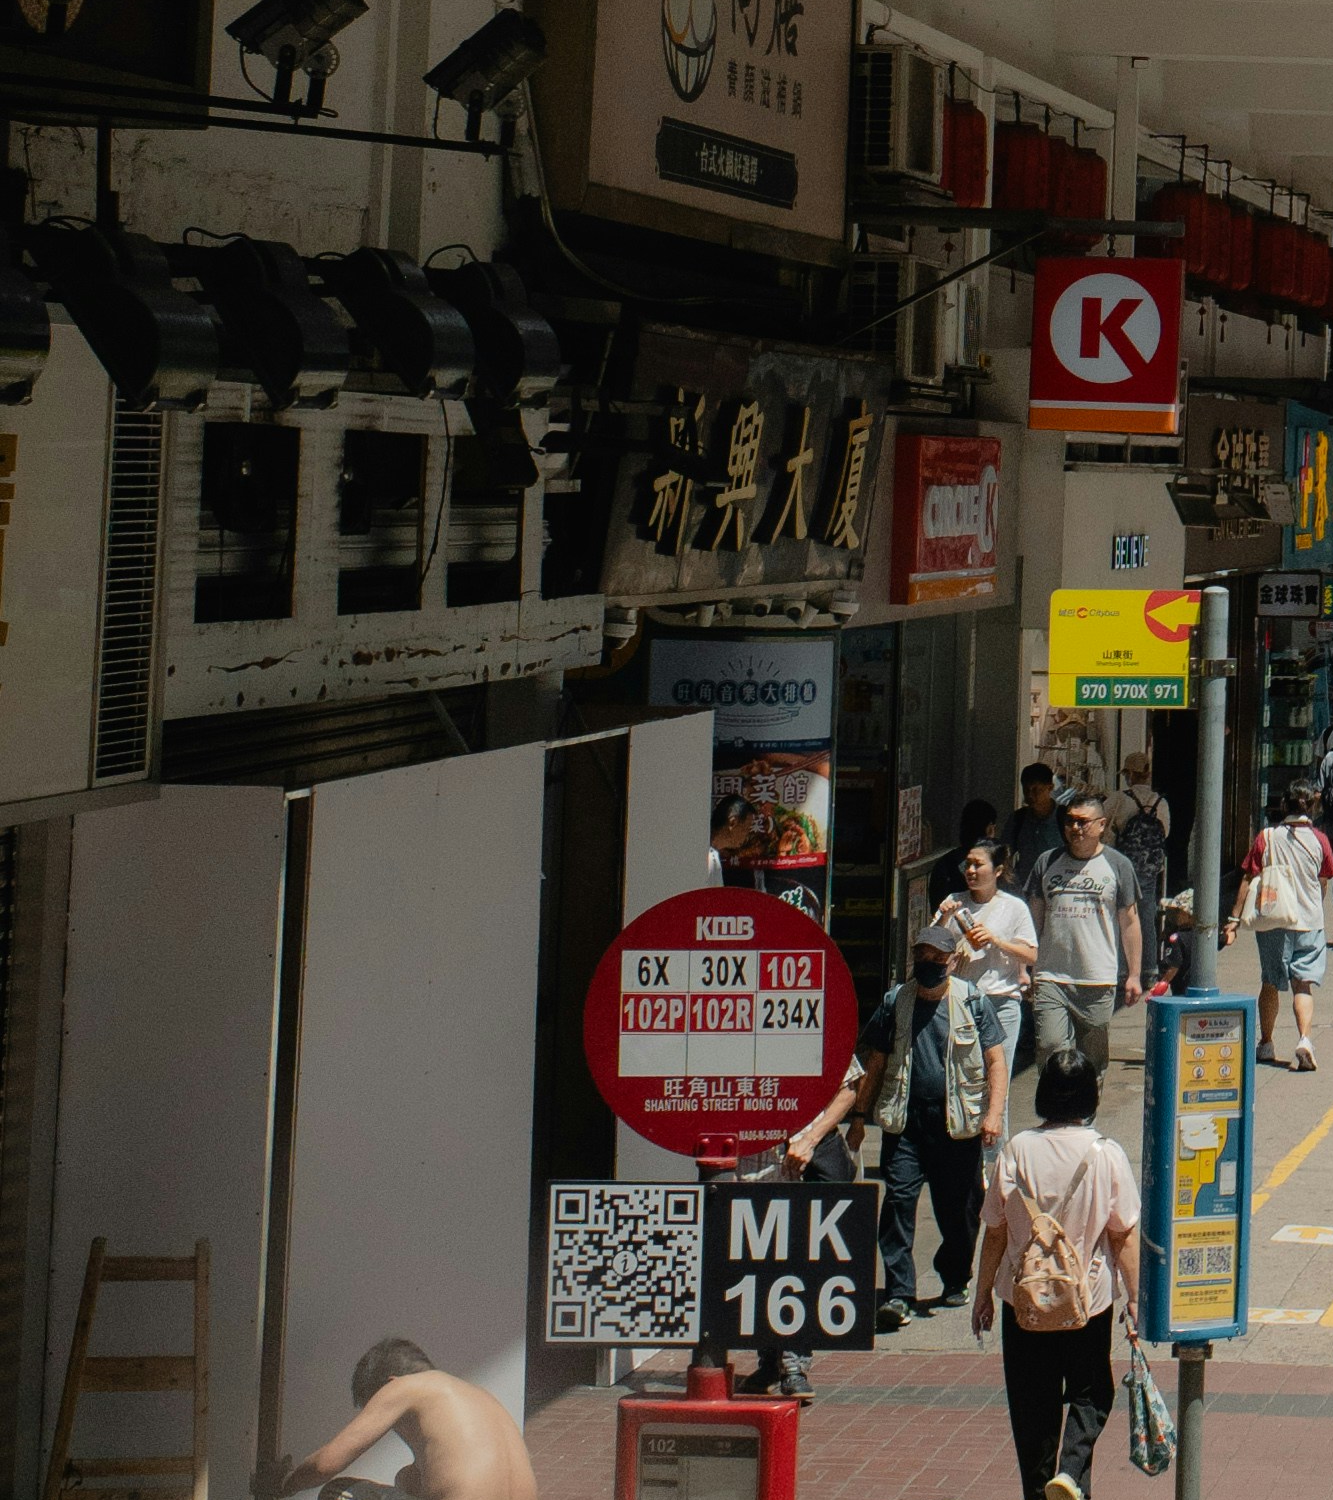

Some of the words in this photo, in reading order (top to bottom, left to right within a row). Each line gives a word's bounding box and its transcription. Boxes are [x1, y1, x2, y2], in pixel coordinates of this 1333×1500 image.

[1080, 297, 1150, 379] K
[923, 485, 980, 538] CIRCLE
[1111, 534, 1150, 569] BELIEVE
[1102, 650, 1133, 660] 山東街
[1082, 684, 1107, 699] 970
[1114, 684, 1148, 699] 970X
[1155, 684, 1178, 699] 971
[695, 916, 755, 941] KMB
[638, 956, 669, 986] 6X
[702, 956, 747, 986] 30X
[767, 956, 812, 988] 102
[623, 999, 684, 1030] 102P
[692, 998, 751, 1030] 102R
[762, 999, 820, 1029] 234X
[664, 1077, 780, 1098] 旺角山東街
[644, 1098, 698, 1112] SHANTUNG
[702, 1098, 739, 1112] STREET
[743, 1098, 773, 1112] MONG
[777, 1098, 798, 1112] KOK
[728, 1198, 854, 1263] MK
[723, 1273, 858, 1339] 166
[647, 1438, 676, 1454] 102
